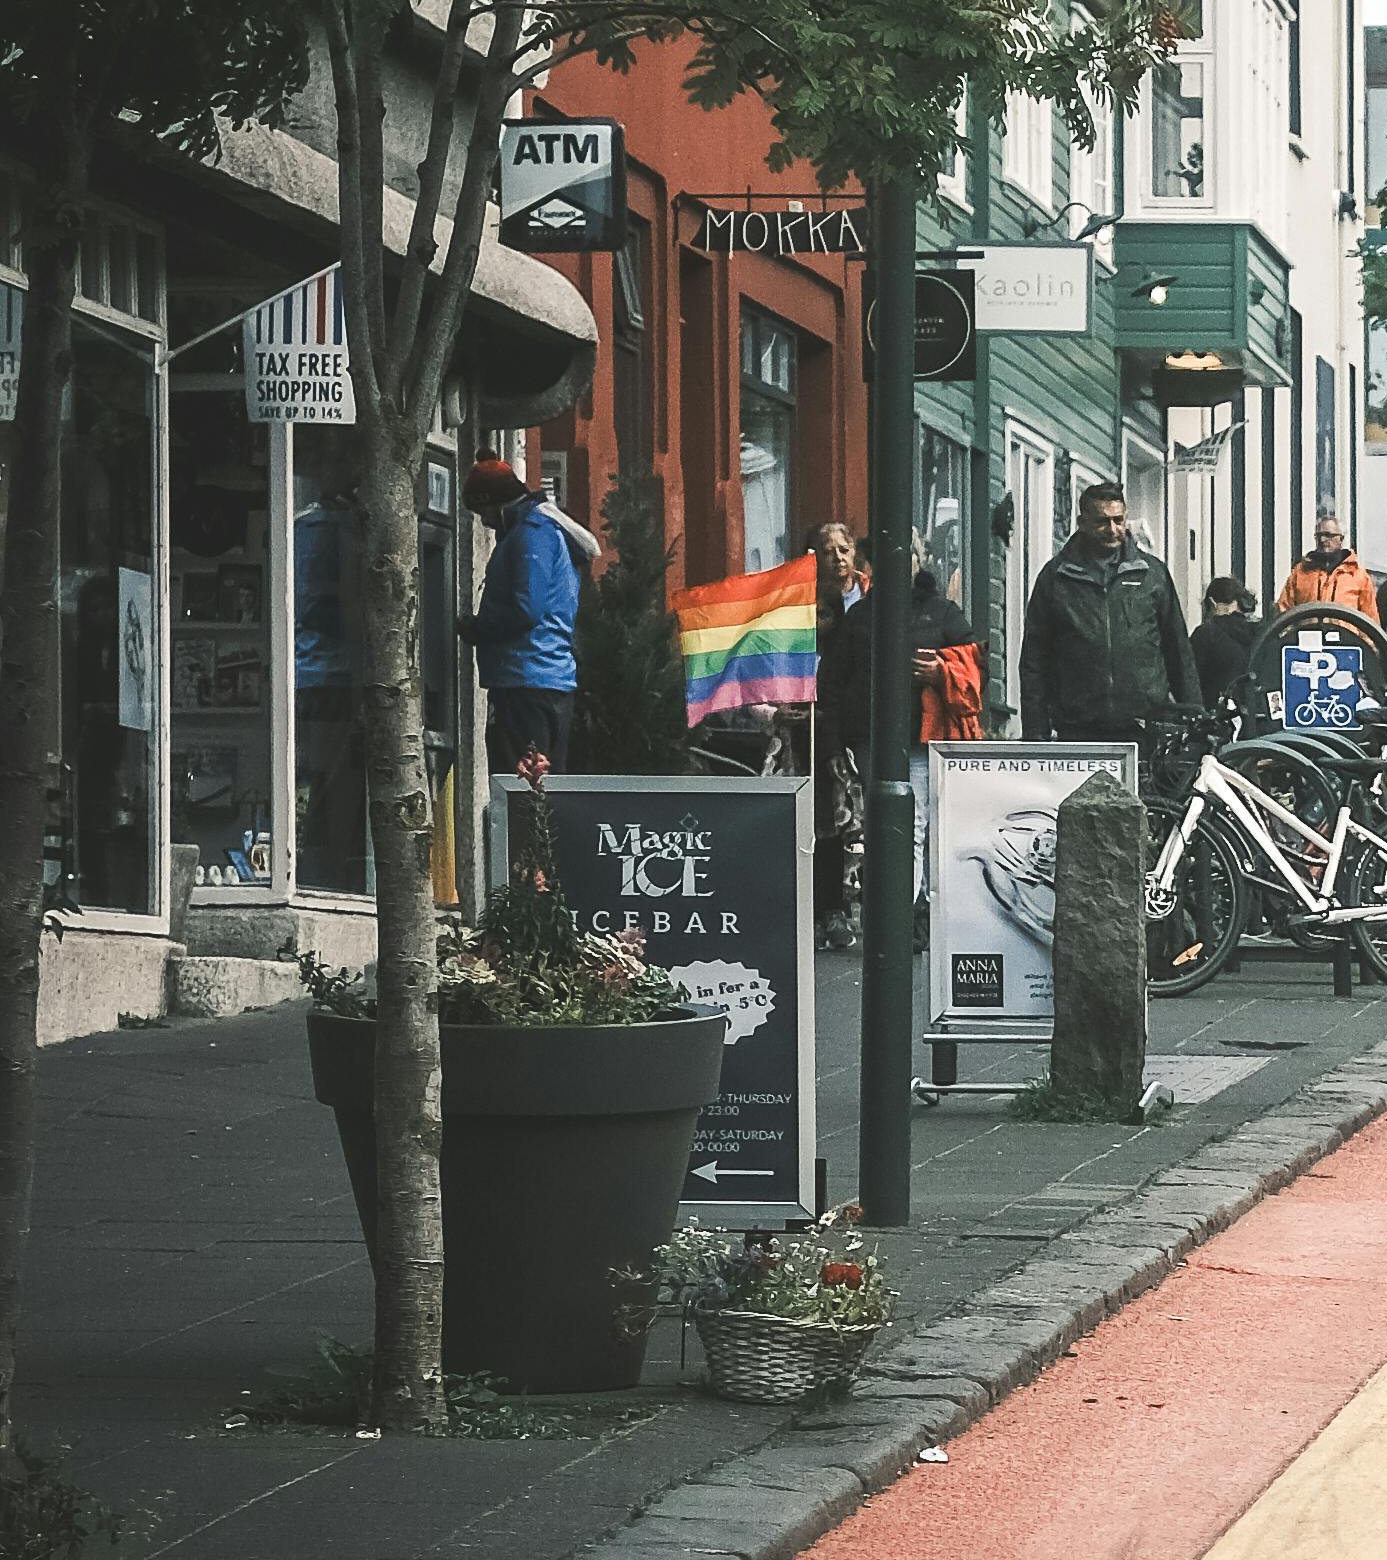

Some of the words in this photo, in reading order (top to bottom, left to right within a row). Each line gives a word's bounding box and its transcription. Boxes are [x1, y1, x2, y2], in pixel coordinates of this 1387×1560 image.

[512, 133, 599, 165] ATM
[705, 209, 866, 260] MOKKA
[976, 273, 1074, 298] Kaolin
[255, 352, 290, 377] TAX
[297, 352, 343, 377] FREE
[256, 380, 343, 403] SHOPPING
[258, 406, 280, 419] SAVE
[285, 406, 299, 420] UP
[303, 406, 316, 420] TO
[321, 406, 342, 420] 14%
[1309, 652, 1338, 690] P
[947, 760, 992, 772] PURE
[998, 760, 1032, 772] AND
[1037, 760, 1119, 772] TIMELESS
[597, 816, 713, 860] Magic
[617, 851, 716, 898] ICE
[956, 958, 999, 972] ANNA
[696, 985, 714, 999] in
[718, 981, 745, 995] for
[749, 980, 760, 991] a
[956, 972, 999, 984] MARIA
